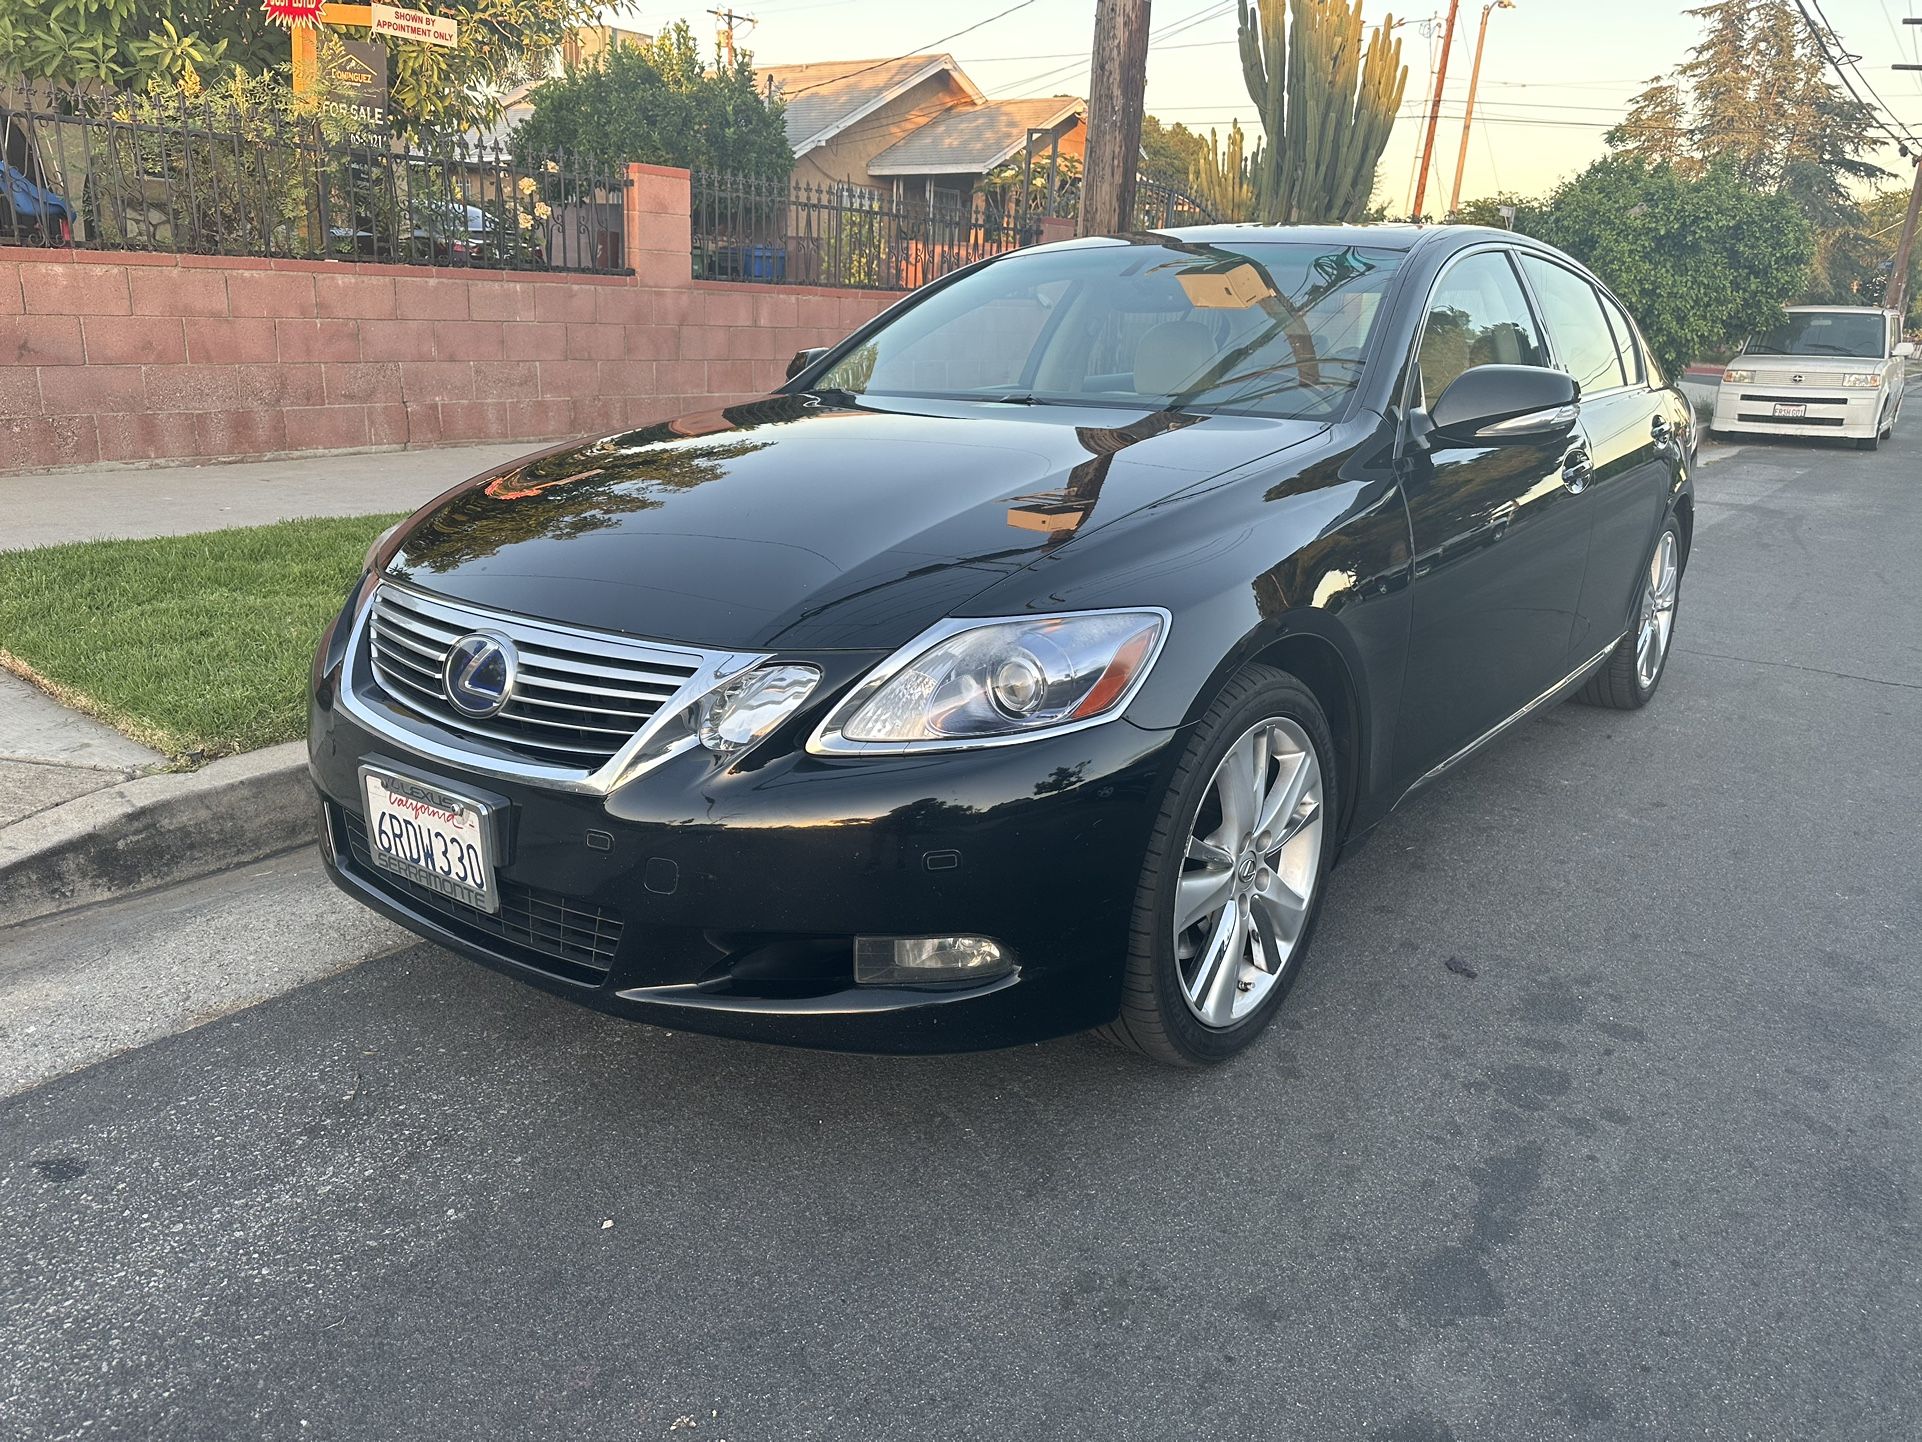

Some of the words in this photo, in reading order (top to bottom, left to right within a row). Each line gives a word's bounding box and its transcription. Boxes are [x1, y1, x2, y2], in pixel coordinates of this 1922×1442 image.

[376, 19, 431, 38] APPOINTMENT
[433, 29, 454, 42] ONLY
[394, 11, 423, 25] SHOWN
[425, 17, 436, 27] BY
[322, 101, 348, 117] FOR
[351, 105, 384, 125] SALE
[401, 783, 453, 810] LEXUS
[378, 811, 485, 889] 6RDW330
[377, 852, 487, 911] SERRAMONTE
